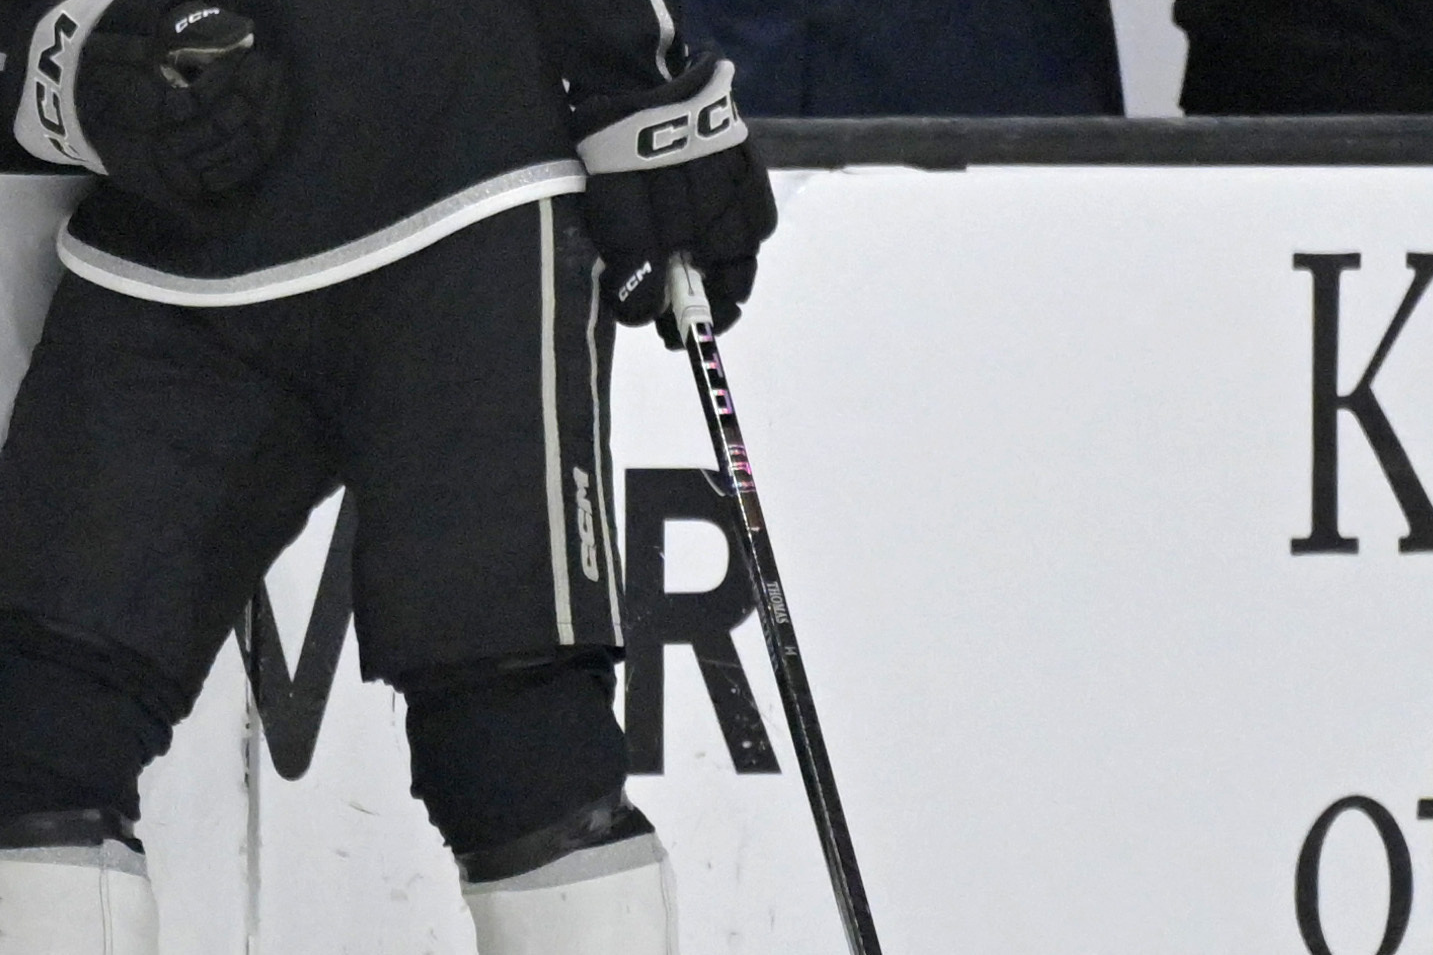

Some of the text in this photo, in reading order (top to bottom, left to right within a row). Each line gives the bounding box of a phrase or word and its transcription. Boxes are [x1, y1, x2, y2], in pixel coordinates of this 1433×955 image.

[175, 7, 221, 35] CCM
[619, 261, 653, 303] CCM
[571, 465, 601, 583] CCM
[766, 580, 791, 626] THOMAS
